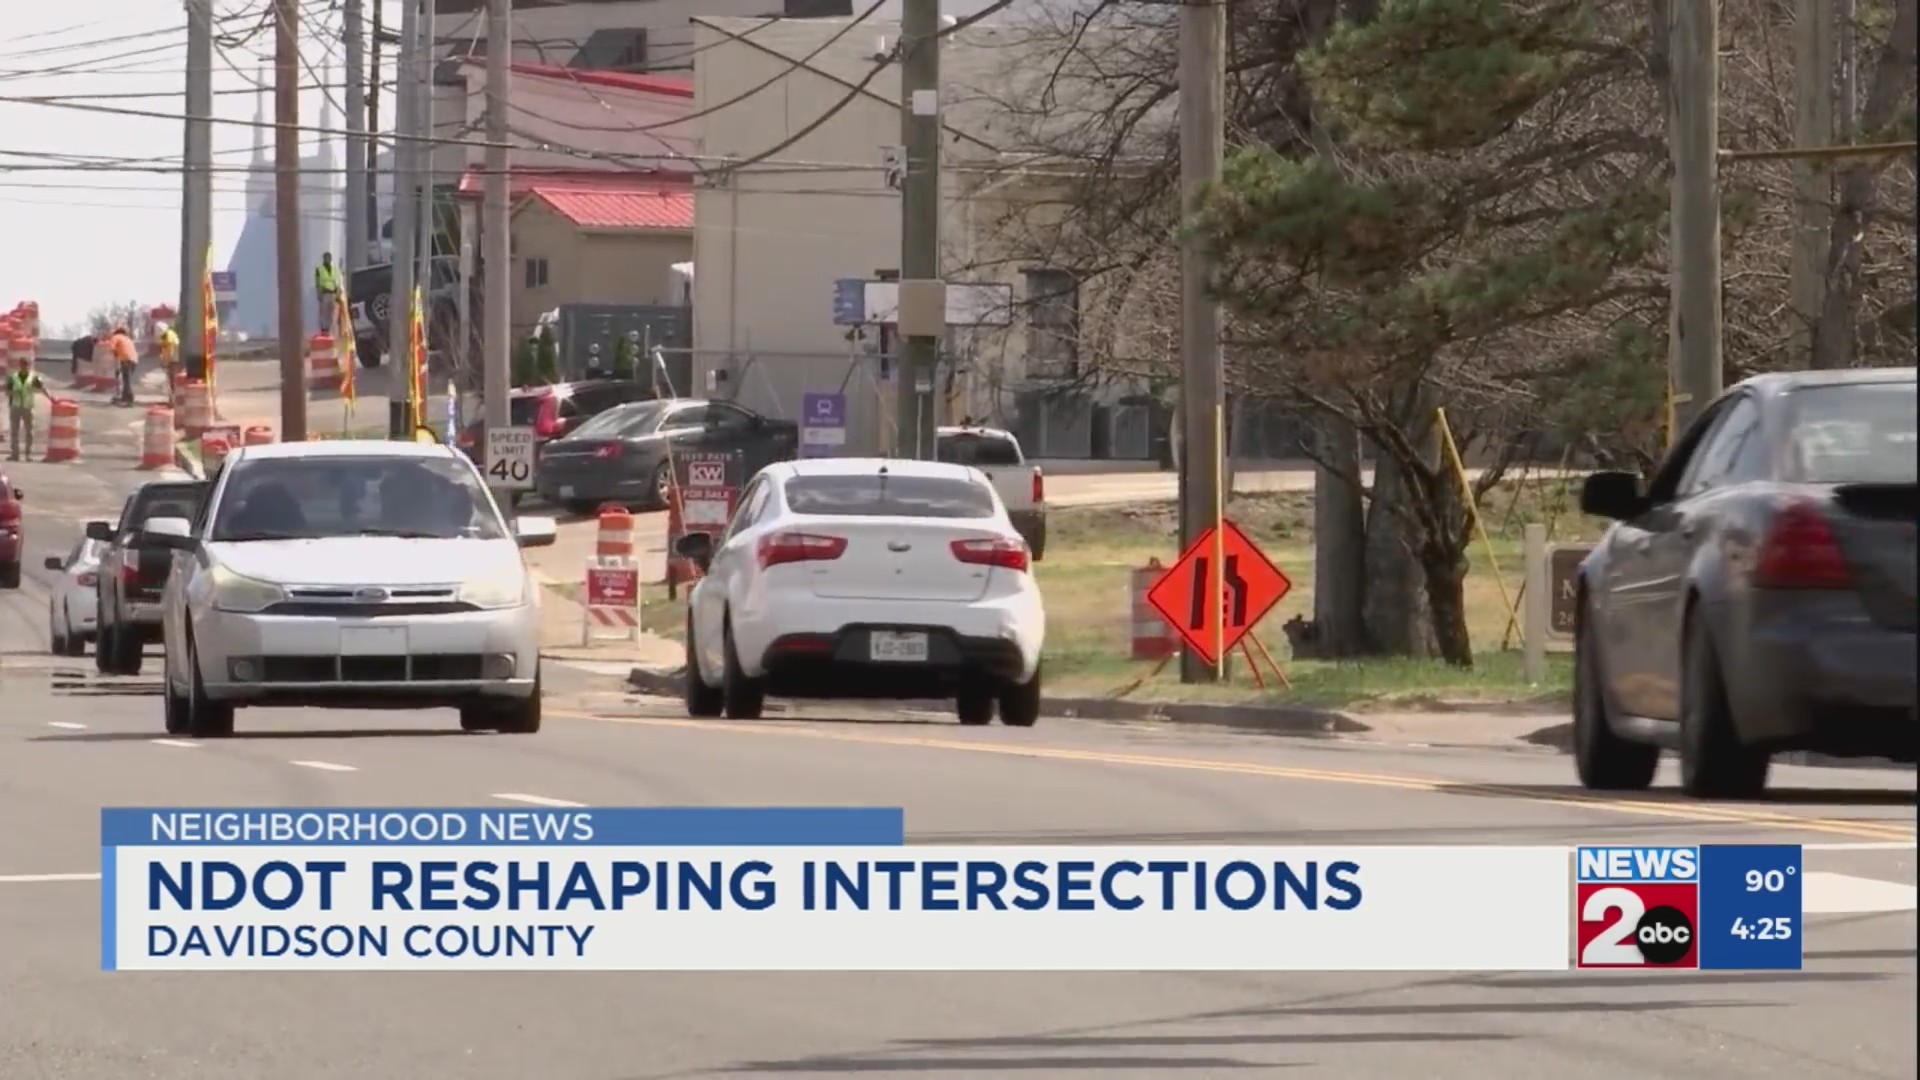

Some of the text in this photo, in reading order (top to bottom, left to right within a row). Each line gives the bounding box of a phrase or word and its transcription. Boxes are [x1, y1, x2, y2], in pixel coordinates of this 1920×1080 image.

[490, 432, 532, 444] SPEED
[493, 444, 526, 456] LIMIT
[489, 457, 529, 482] 40
[691, 463, 721, 480] KW
[683, 489, 728, 499] FOR SALE
